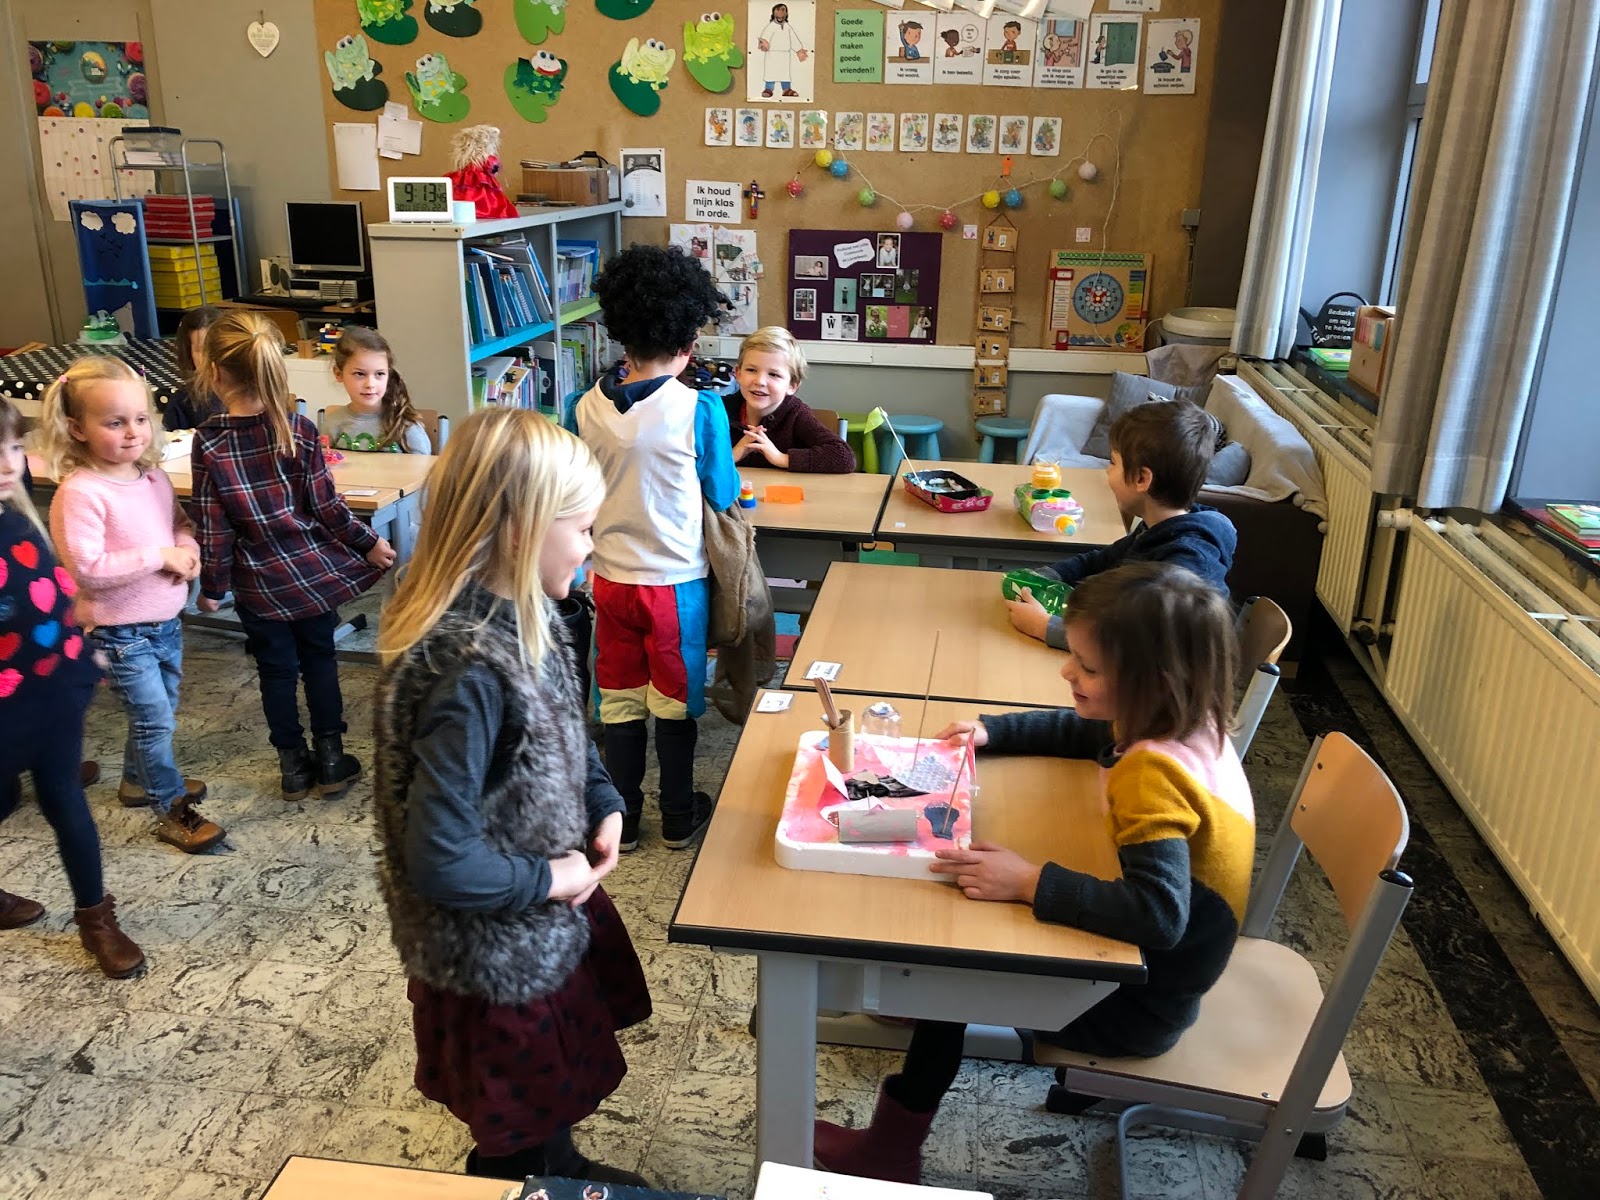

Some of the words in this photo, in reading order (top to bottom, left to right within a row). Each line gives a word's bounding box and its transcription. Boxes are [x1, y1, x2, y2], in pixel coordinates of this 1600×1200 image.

[405, 183, 436, 202] 9:13
[697, 186, 705, 194] Ik
[707, 186, 731, 196] houd
[693, 197, 713, 207] mijn
[715, 198, 734, 207] klas
[696, 208, 704, 216] in
[707, 210, 730, 218] orde.
